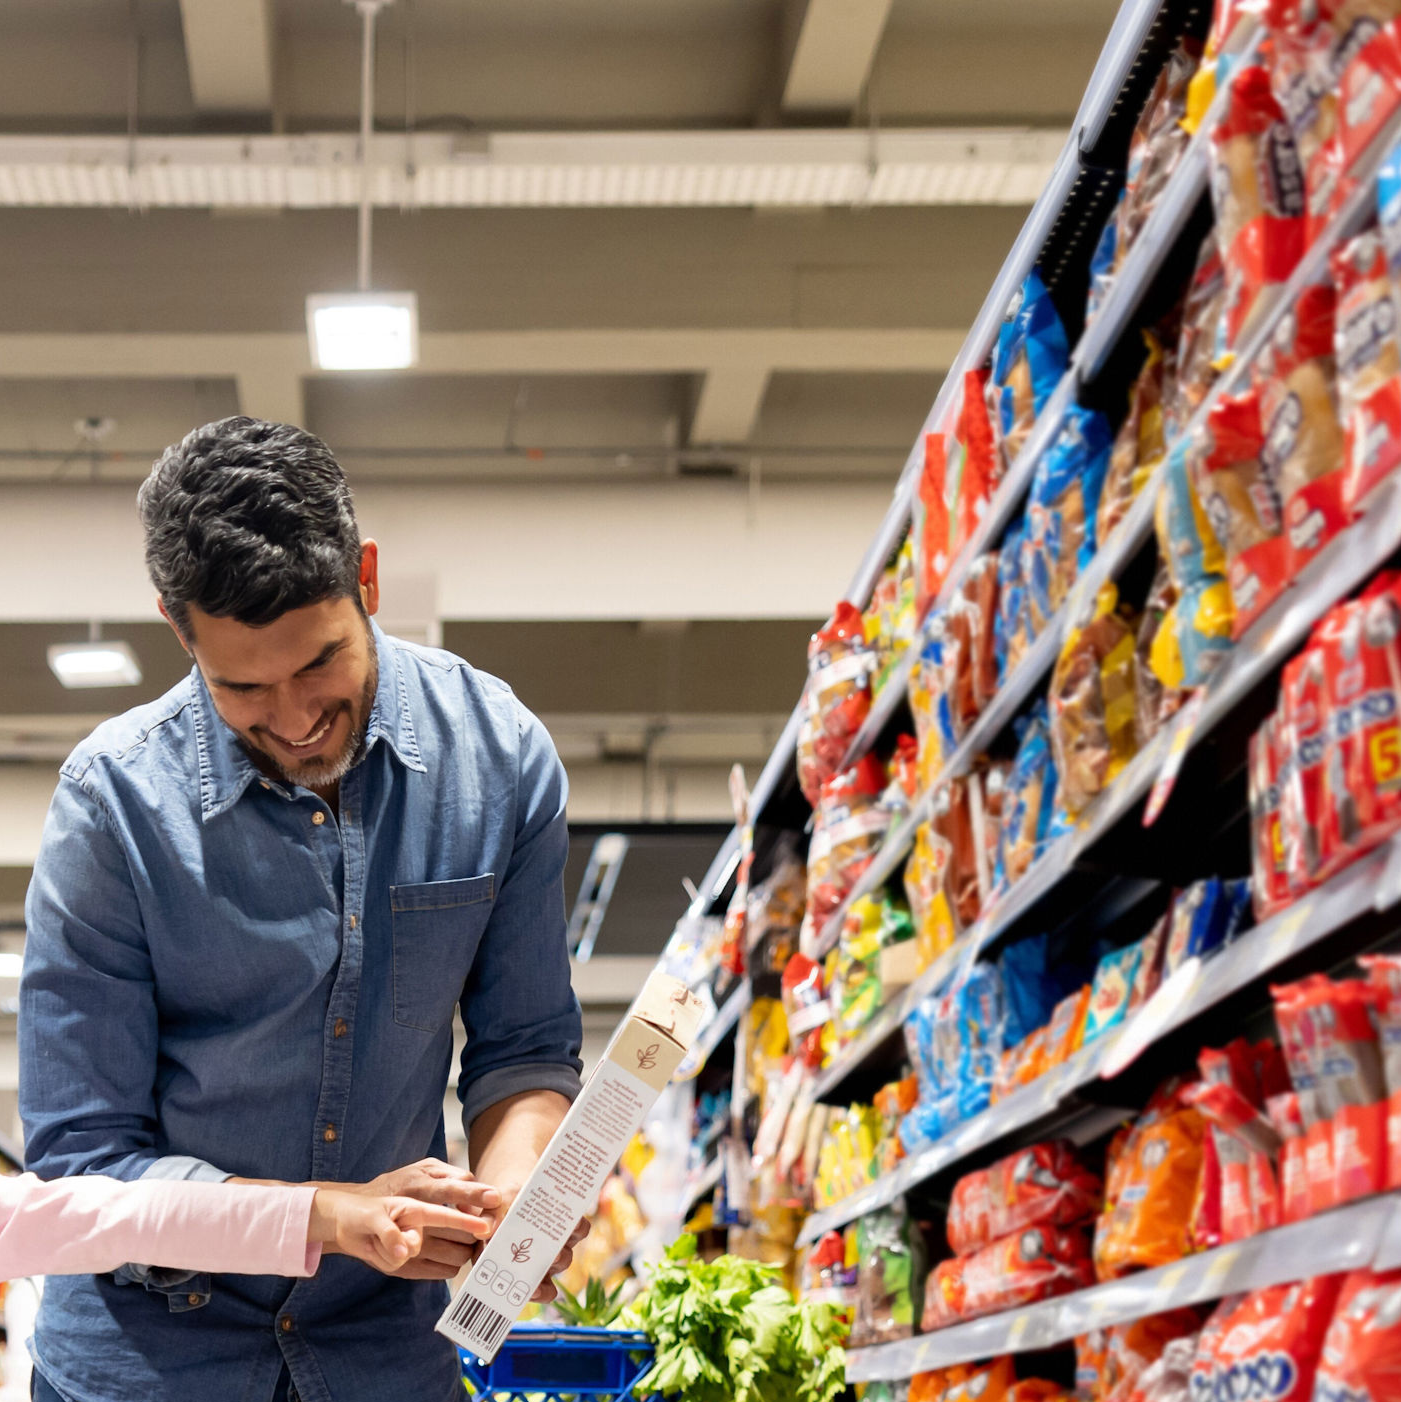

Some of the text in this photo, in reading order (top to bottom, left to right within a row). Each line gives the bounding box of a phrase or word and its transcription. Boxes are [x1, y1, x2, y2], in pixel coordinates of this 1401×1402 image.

[573, 1139, 587, 1150] need
[581, 1153, 599, 1166] before
[583, 1163, 598, 1174] After
[579, 1169, 594, 1181] keep
[578, 1183, 587, 1191] the
[582, 1179, 593, 1188] and
[563, 1183, 586, 1199] possible
[564, 1211, 574, 1220] free
